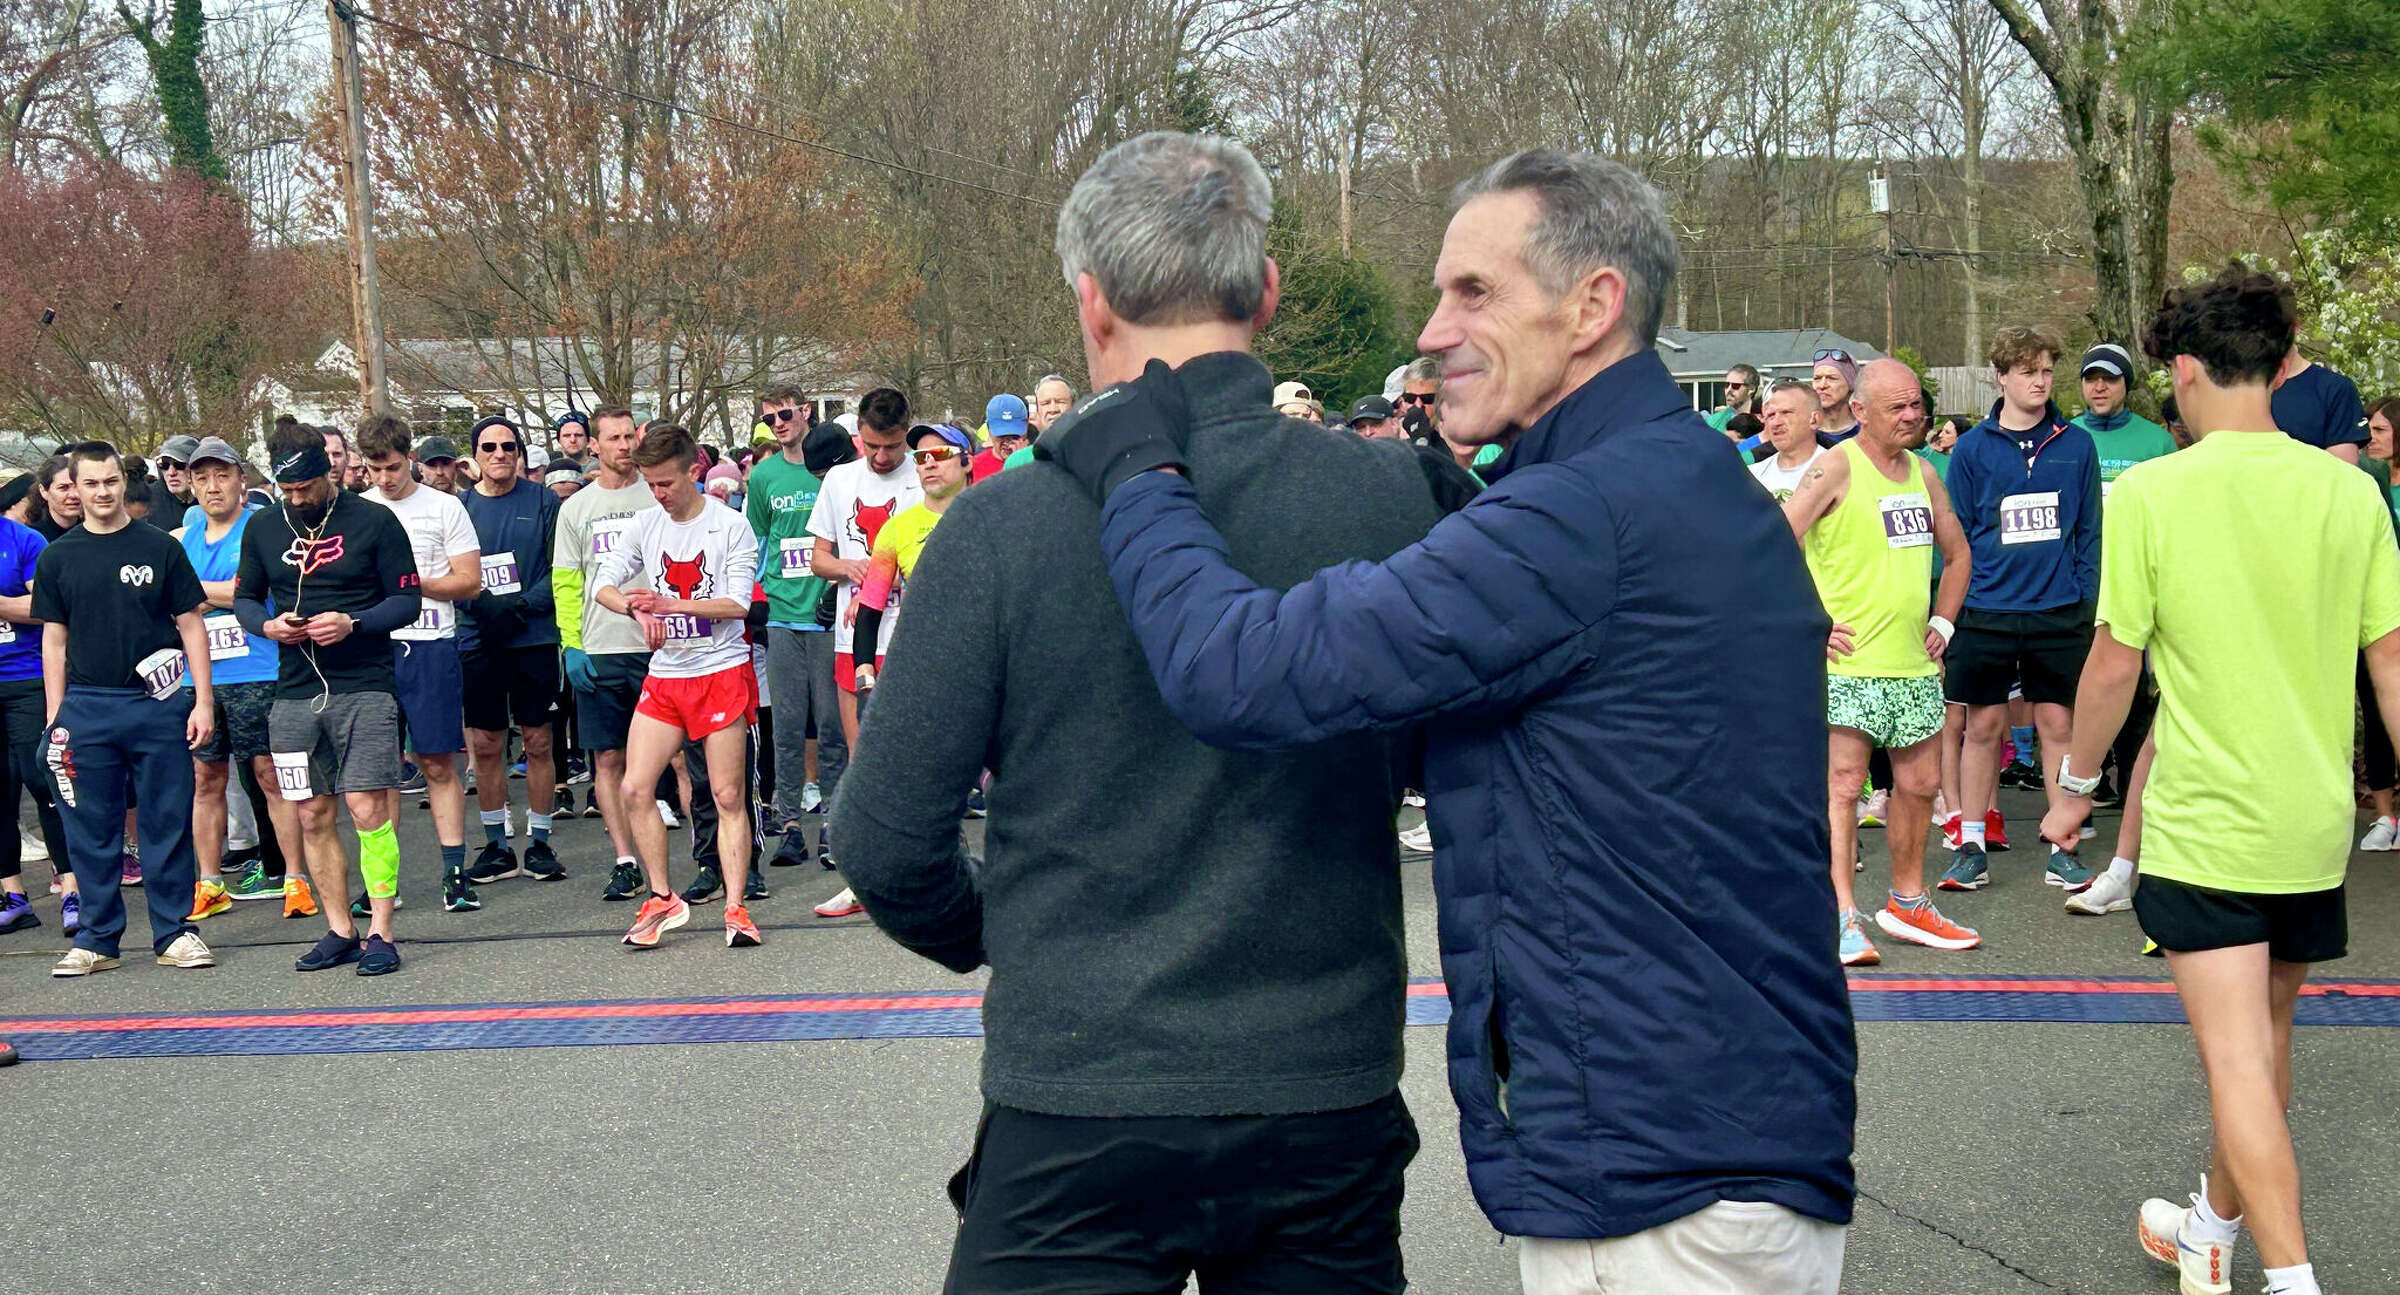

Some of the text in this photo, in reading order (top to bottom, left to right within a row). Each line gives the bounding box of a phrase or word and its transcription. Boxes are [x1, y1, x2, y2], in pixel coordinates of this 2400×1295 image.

[770, 494, 794, 510] ion
[1892, 508, 1928, 534] 836
[2006, 507, 2057, 532] 1198
[596, 531, 622, 552] 10
[664, 616, 700, 639] 691
